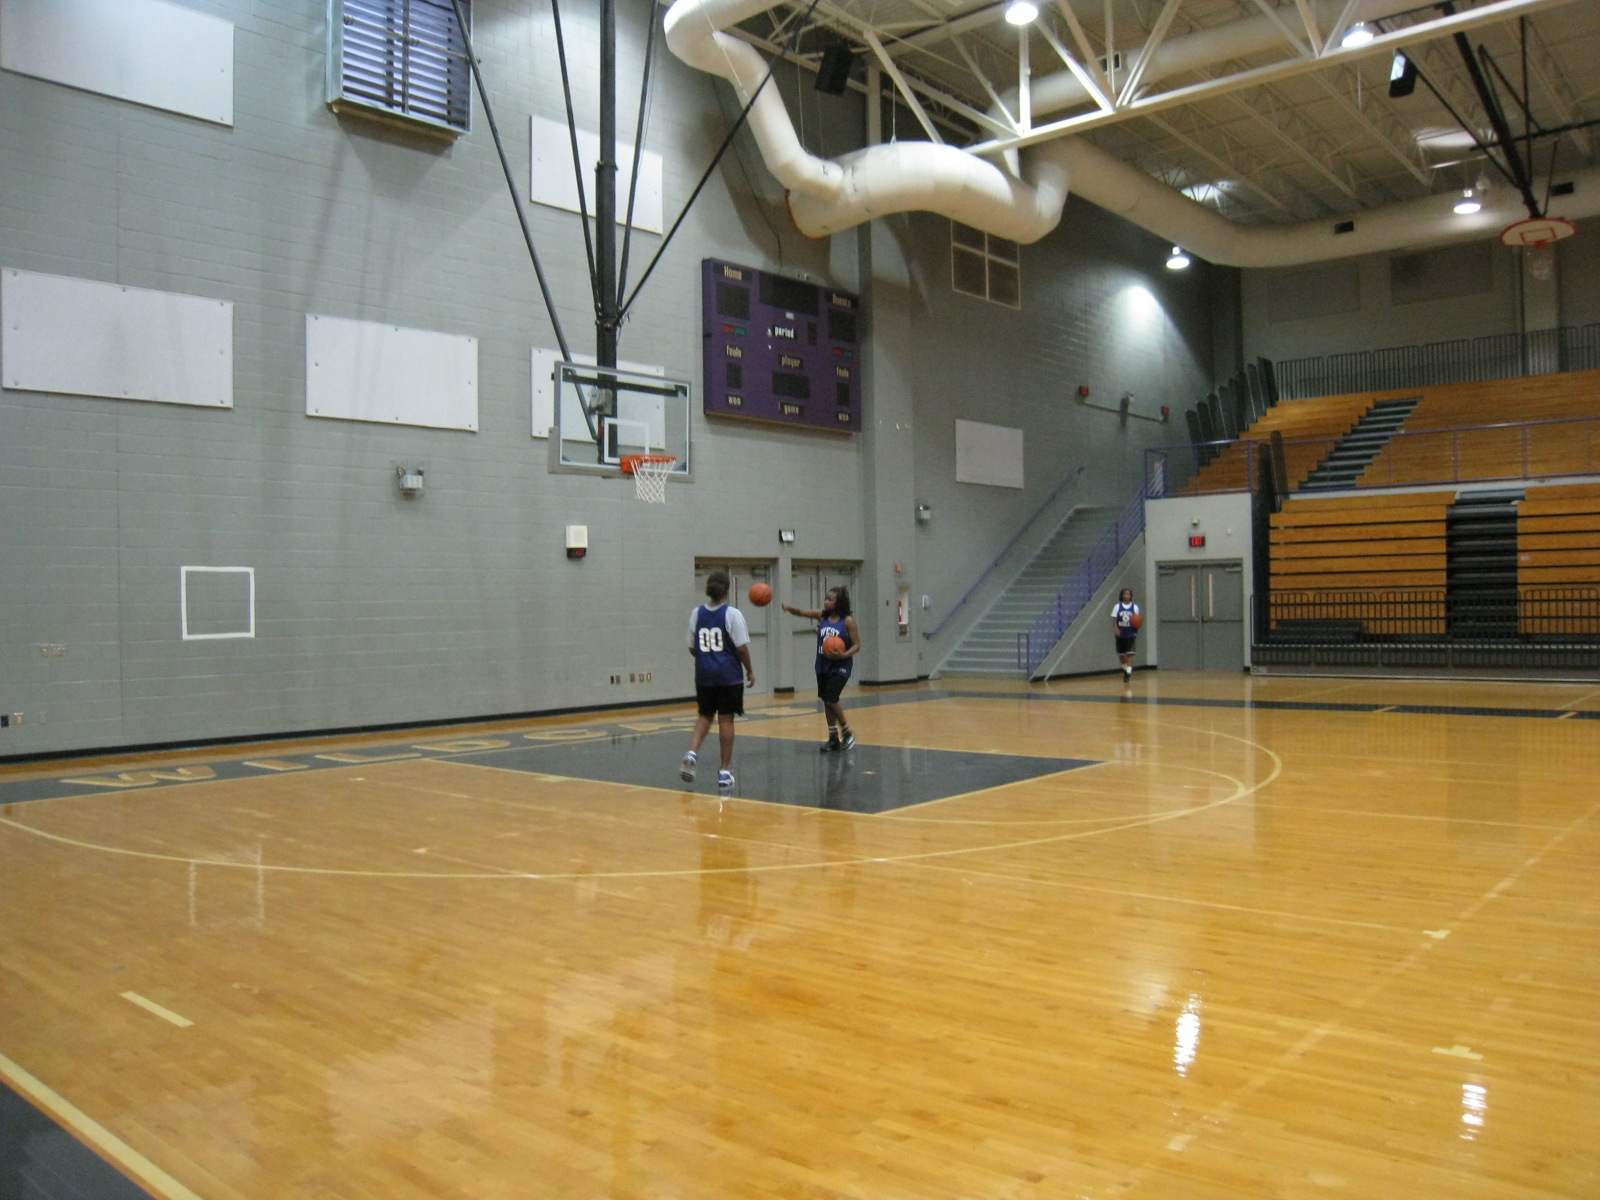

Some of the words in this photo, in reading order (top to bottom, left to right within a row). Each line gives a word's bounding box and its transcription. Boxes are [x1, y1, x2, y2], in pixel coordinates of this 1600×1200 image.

[724, 266, 742, 280] Home
[774, 325, 795, 339] period
[781, 355, 801, 368] player
[783, 404, 800, 415] game
[820, 626, 840, 637] WEST
[698, 627, 724, 652] 00
